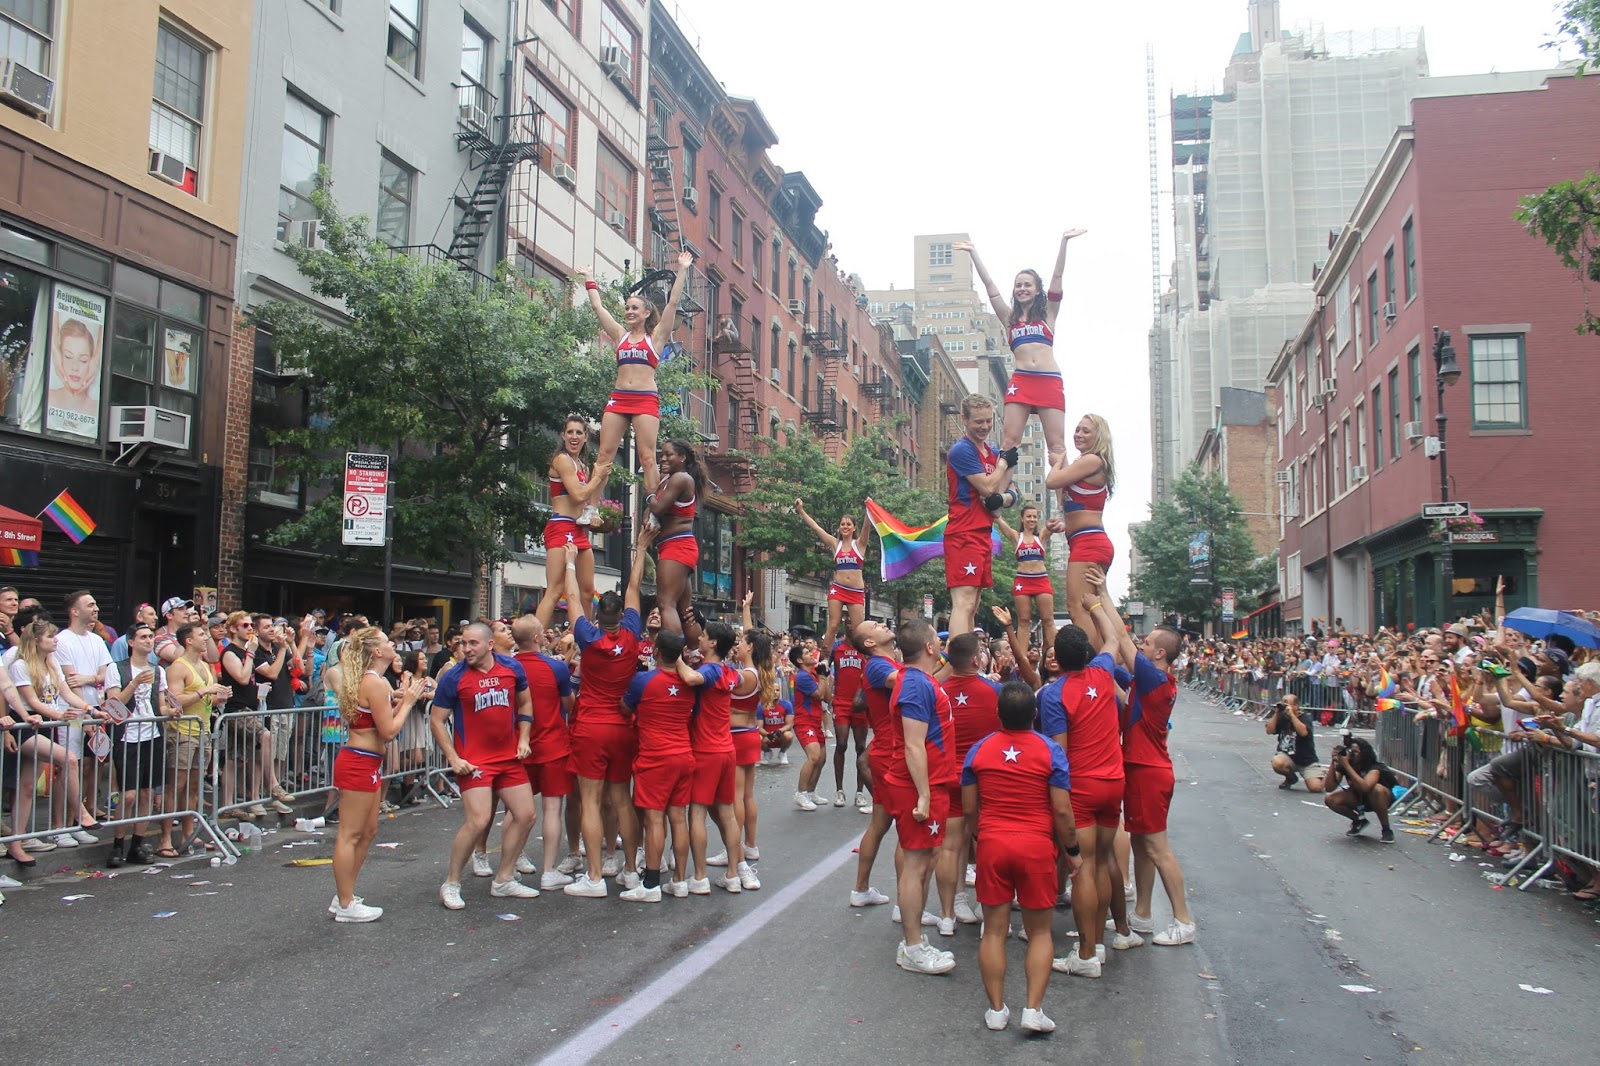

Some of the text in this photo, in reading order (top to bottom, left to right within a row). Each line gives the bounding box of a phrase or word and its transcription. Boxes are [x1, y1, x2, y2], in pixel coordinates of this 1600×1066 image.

[57, 290, 102, 313] Rejuvenating
[58, 302, 69, 311] Skin
[49, 408, 65, 419] (212)
[4, 530, 16, 540] 8th
[17, 532, 36, 542] Street
[478, 677, 500, 688] CHEER
